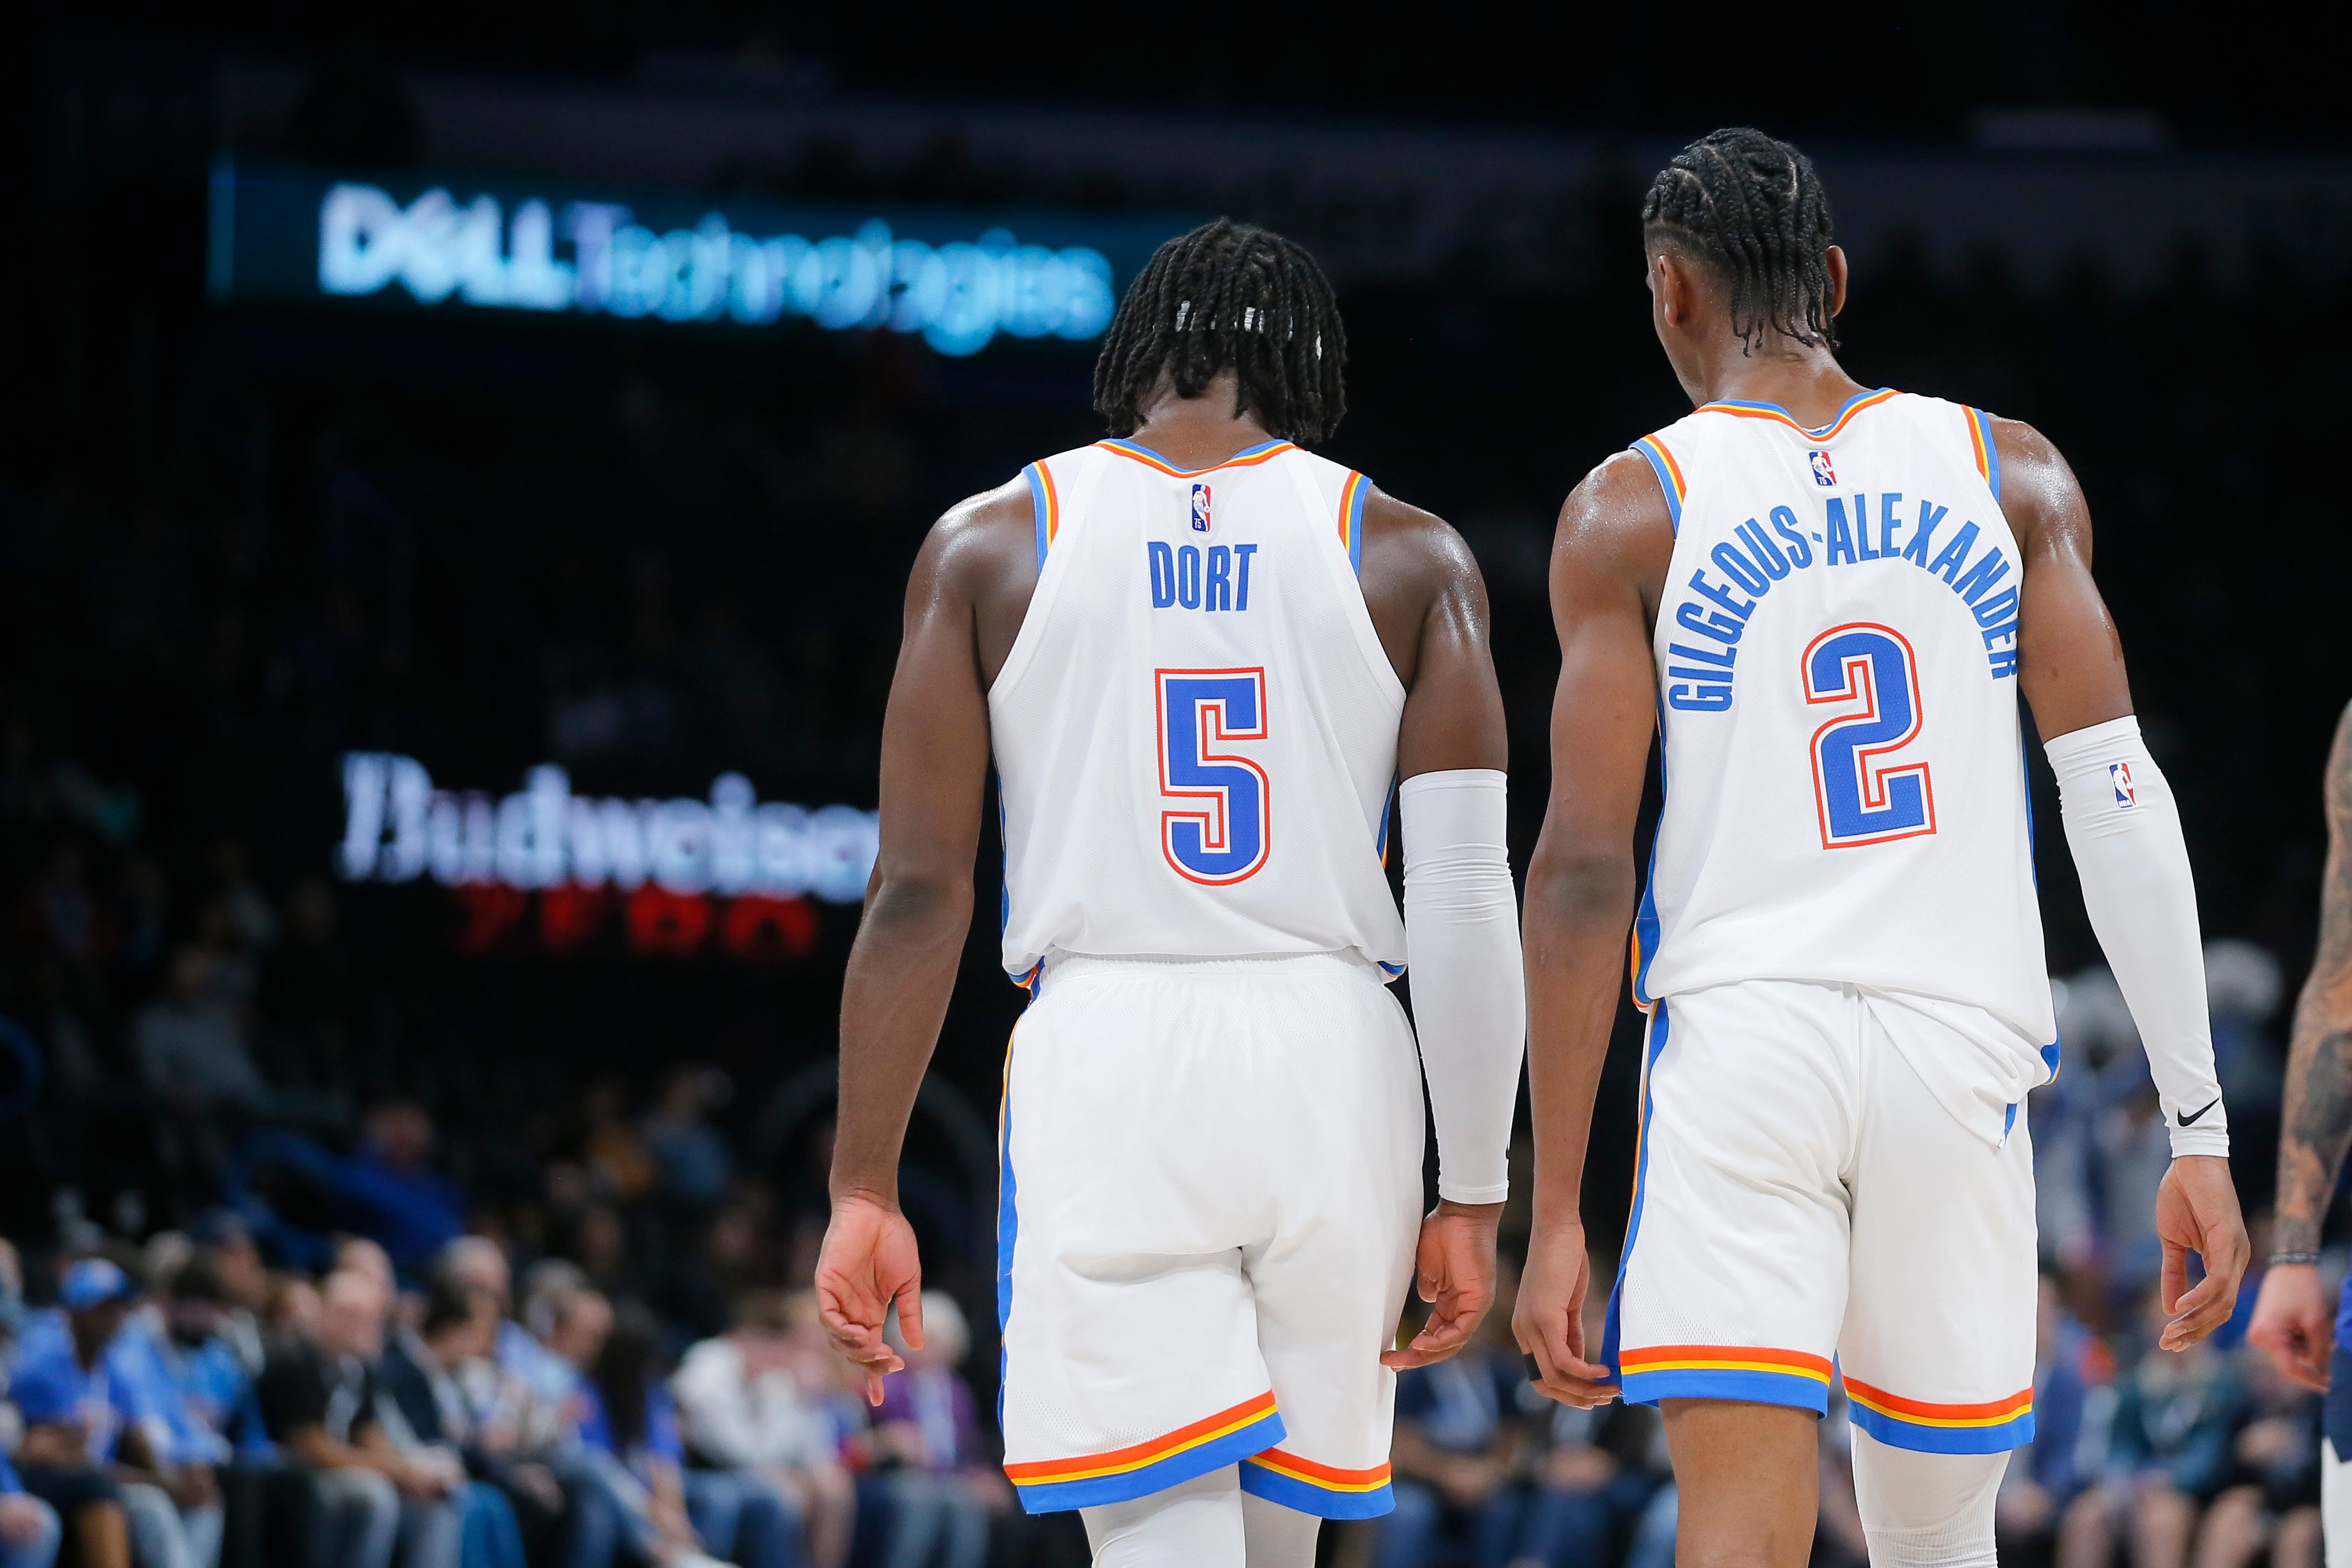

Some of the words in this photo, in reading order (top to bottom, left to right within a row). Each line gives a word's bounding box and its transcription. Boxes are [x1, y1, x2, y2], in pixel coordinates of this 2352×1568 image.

[1194, 518, 1201, 529] 75
[1818, 477, 1827, 485] 75
[1148, 541, 1257, 612] DORT
[1155, 666, 1270, 886] 5
[1801, 622, 1937, 850] 2
[334, 750, 880, 903] Budweise
